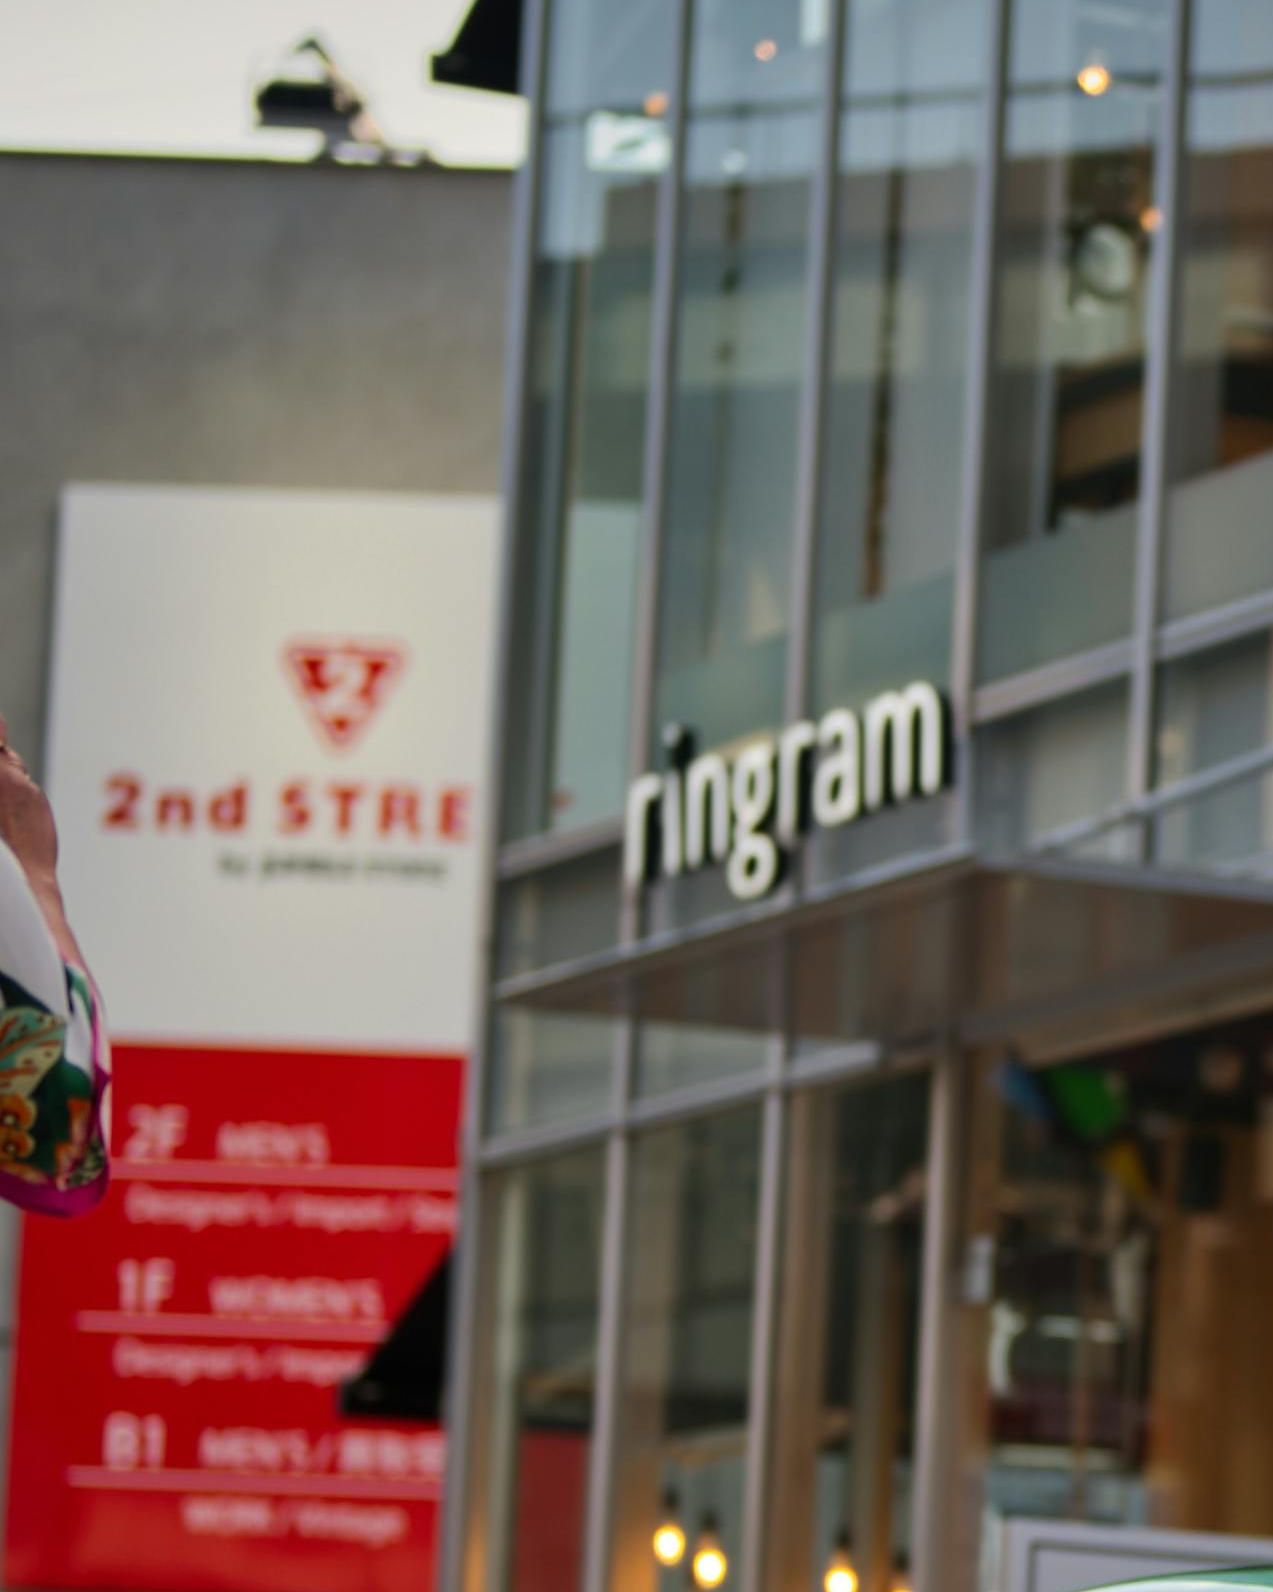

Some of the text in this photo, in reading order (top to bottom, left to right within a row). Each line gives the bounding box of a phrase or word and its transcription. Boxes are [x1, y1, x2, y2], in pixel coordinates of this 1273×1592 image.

[100, 769, 248, 835] 2nd
[624, 679, 948, 901] ringram
[118, 1257, 175, 1315] 1F
